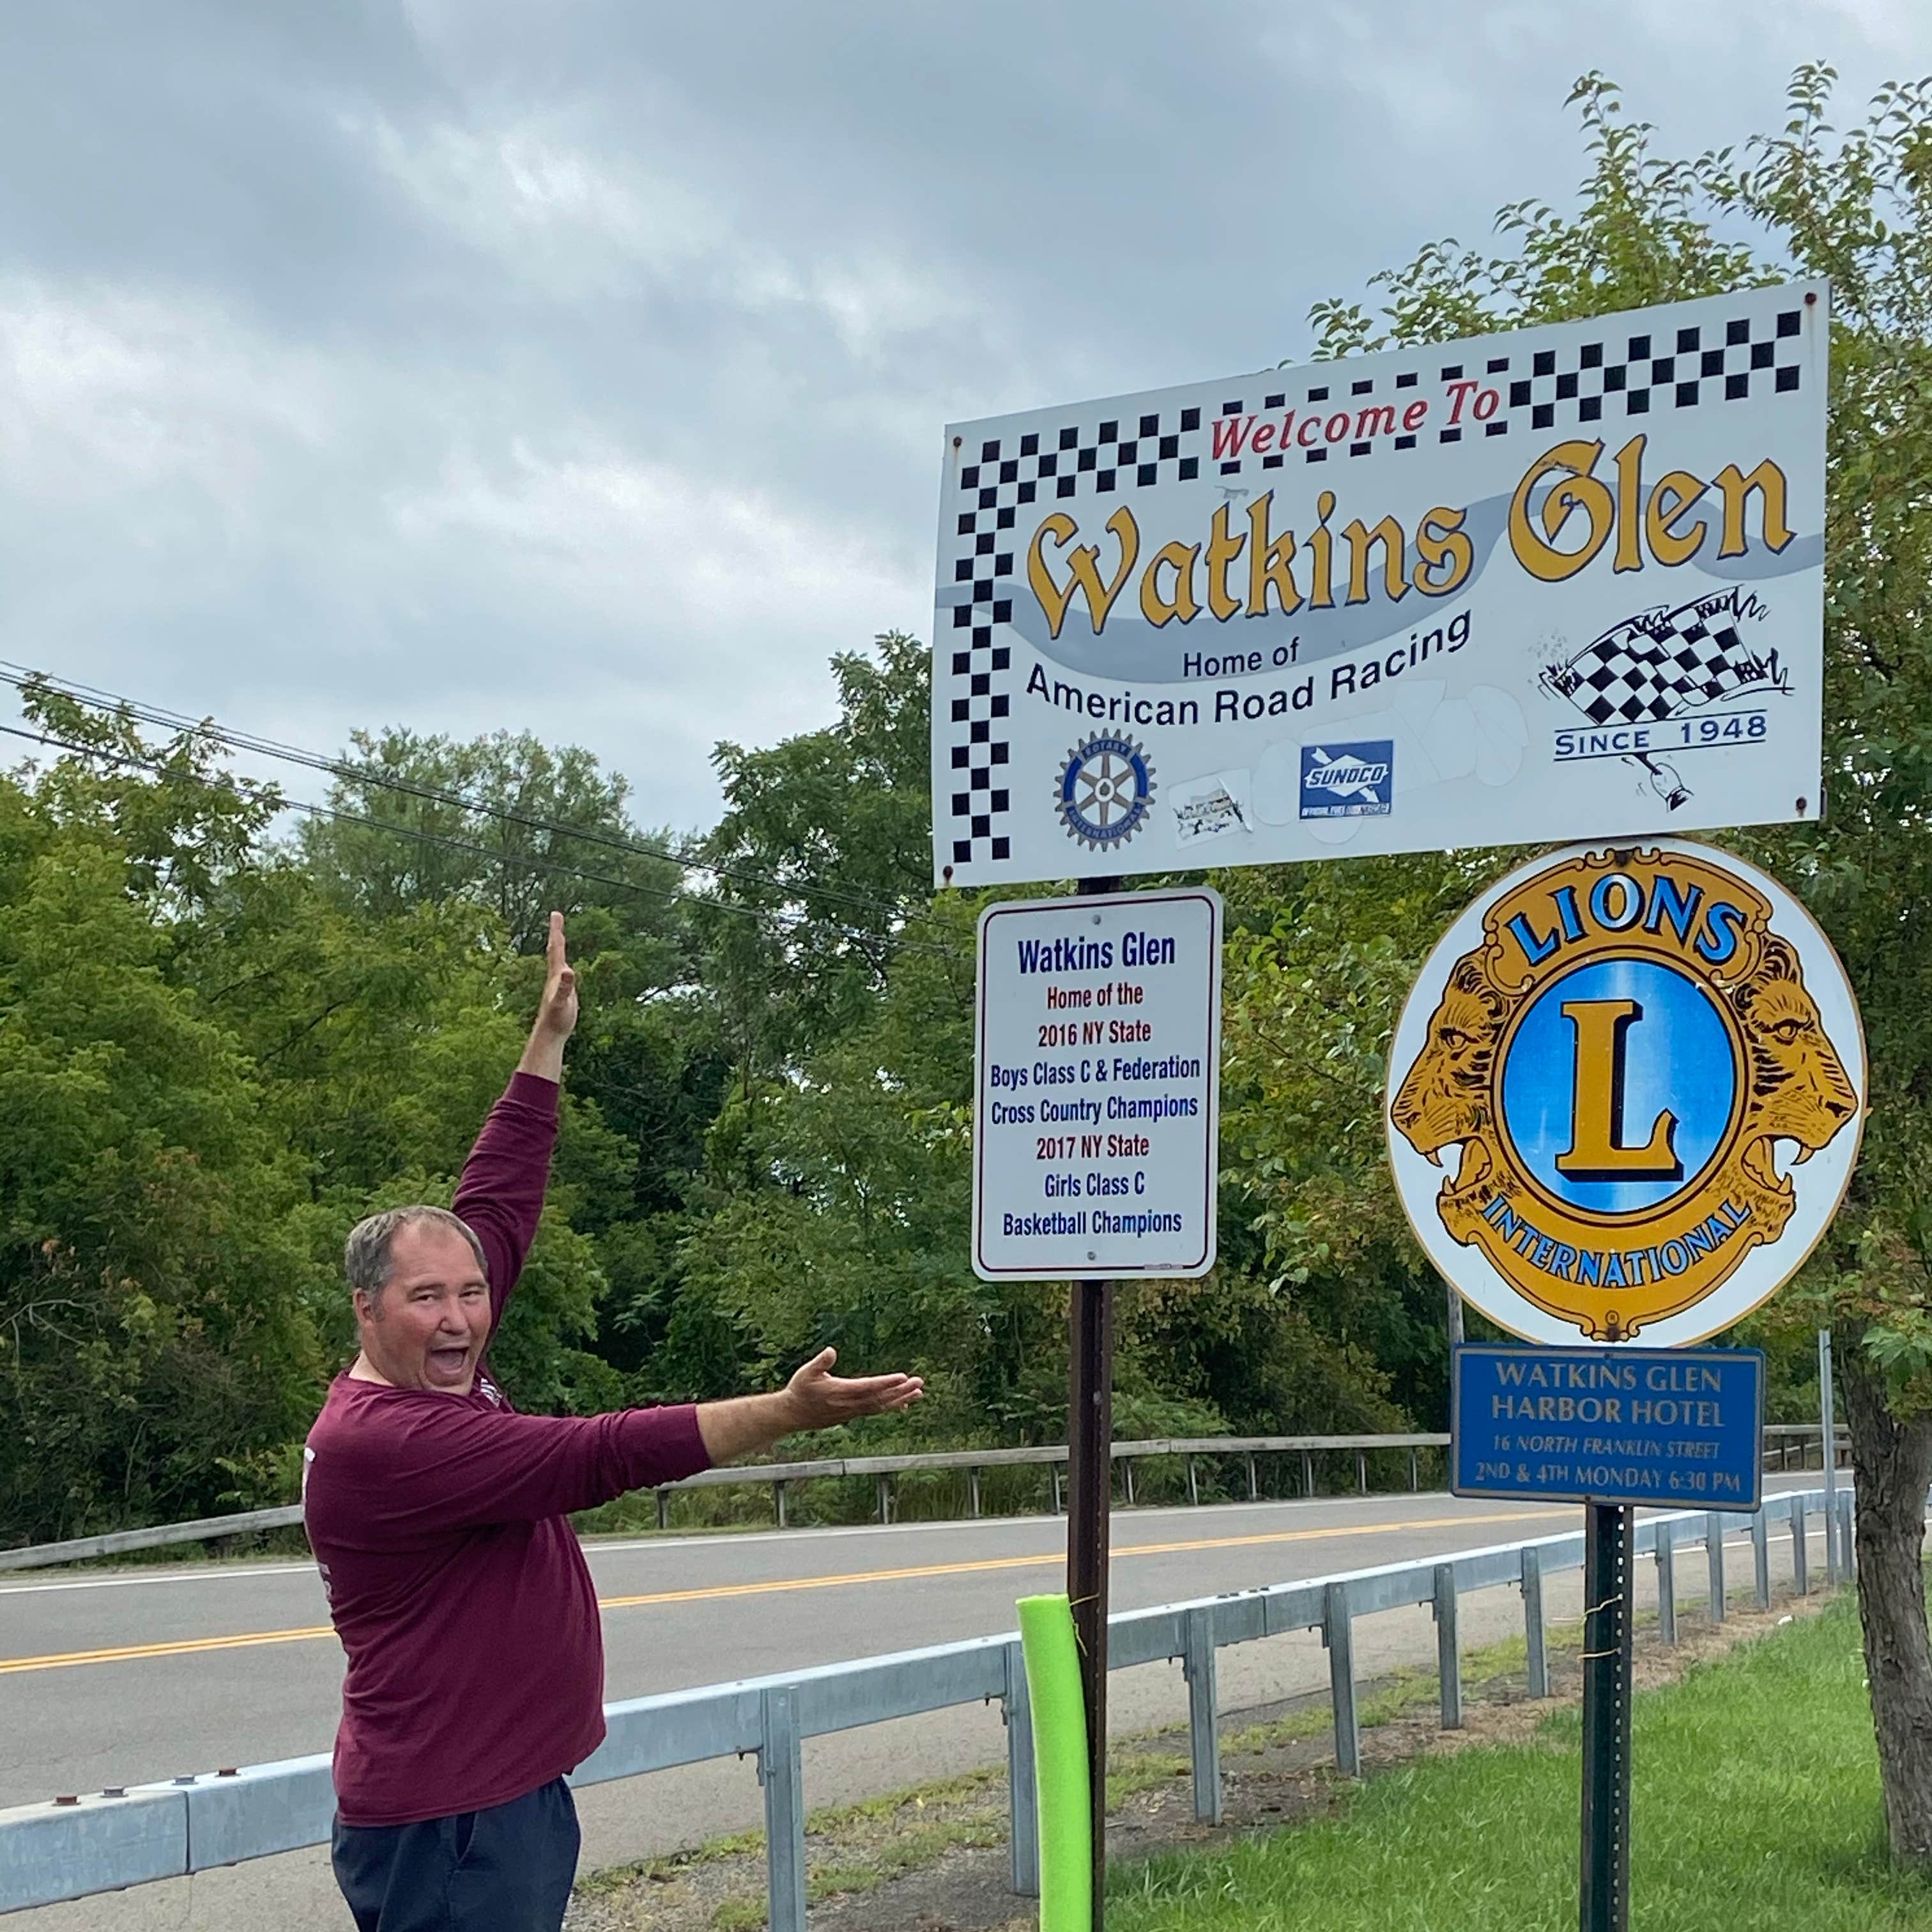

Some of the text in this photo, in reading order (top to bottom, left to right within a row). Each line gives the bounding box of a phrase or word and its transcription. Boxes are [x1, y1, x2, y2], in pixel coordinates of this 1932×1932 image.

[1211, 381, 1499, 461] Welcome To
[1027, 434, 1797, 640] Watkins Glen
[1027, 610, 1471, 724] American Road Racing
[1183, 637, 1300, 677] Home of
[1555, 715, 1767, 756] SINCE 1948
[1310, 766, 1385, 785] SUNOCO
[1508, 872, 1748, 965] LIONS
[1018, 931, 1176, 974] Watkins Glen
[1047, 982, 1143, 1009] Home of the
[1038, 1020, 1151, 1047] 2016 NY State
[991, 1055, 1200, 1091] Boys Class C & Federation
[1555, 999, 1683, 1182] L
[992, 1093, 1198, 1125] Cross Country Champions
[1036, 1134, 1149, 1160] 2017 NY State
[1045, 1171, 1145, 1197] Girls Class C
[1003, 1209, 1182, 1238] Basketball Champions
[1481, 1192, 1750, 1288] INTERNATIONAL
[1495, 1361, 1721, 1393] WATKINS GLEN
[1492, 1395, 1726, 1428] HARBOR HOTEL
[1493, 1435, 1720, 1459] 16 NORTH FRANKLIN STREET
[1475, 1462, 1742, 1492] 2ND & 4TH MONDAY 6:30 PM
